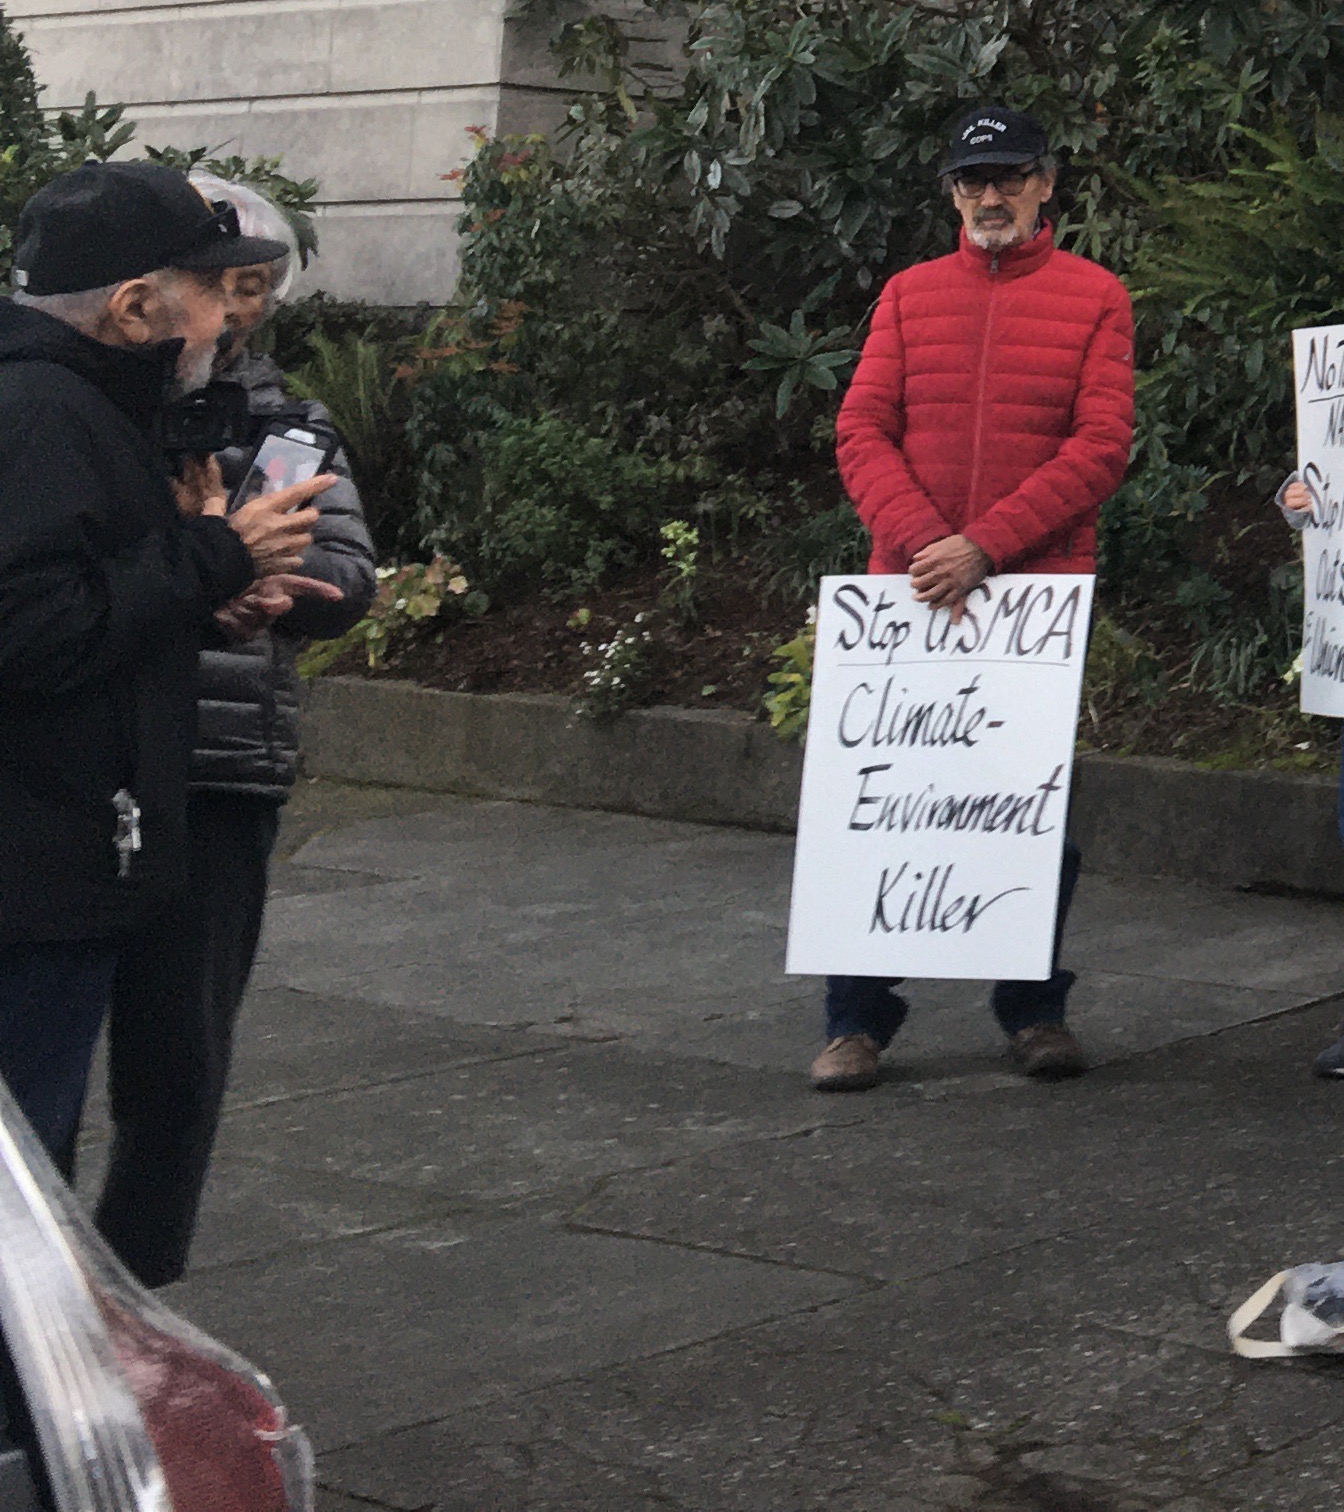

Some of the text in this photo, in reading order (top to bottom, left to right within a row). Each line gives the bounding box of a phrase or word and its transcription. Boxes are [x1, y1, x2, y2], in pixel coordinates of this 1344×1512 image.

[1301, 337, 1337, 394] No
[833, 582, 1083, 667] Stop USMCA
[848, 763, 1066, 837] Environment
[868, 861, 1031, 935] Killer
